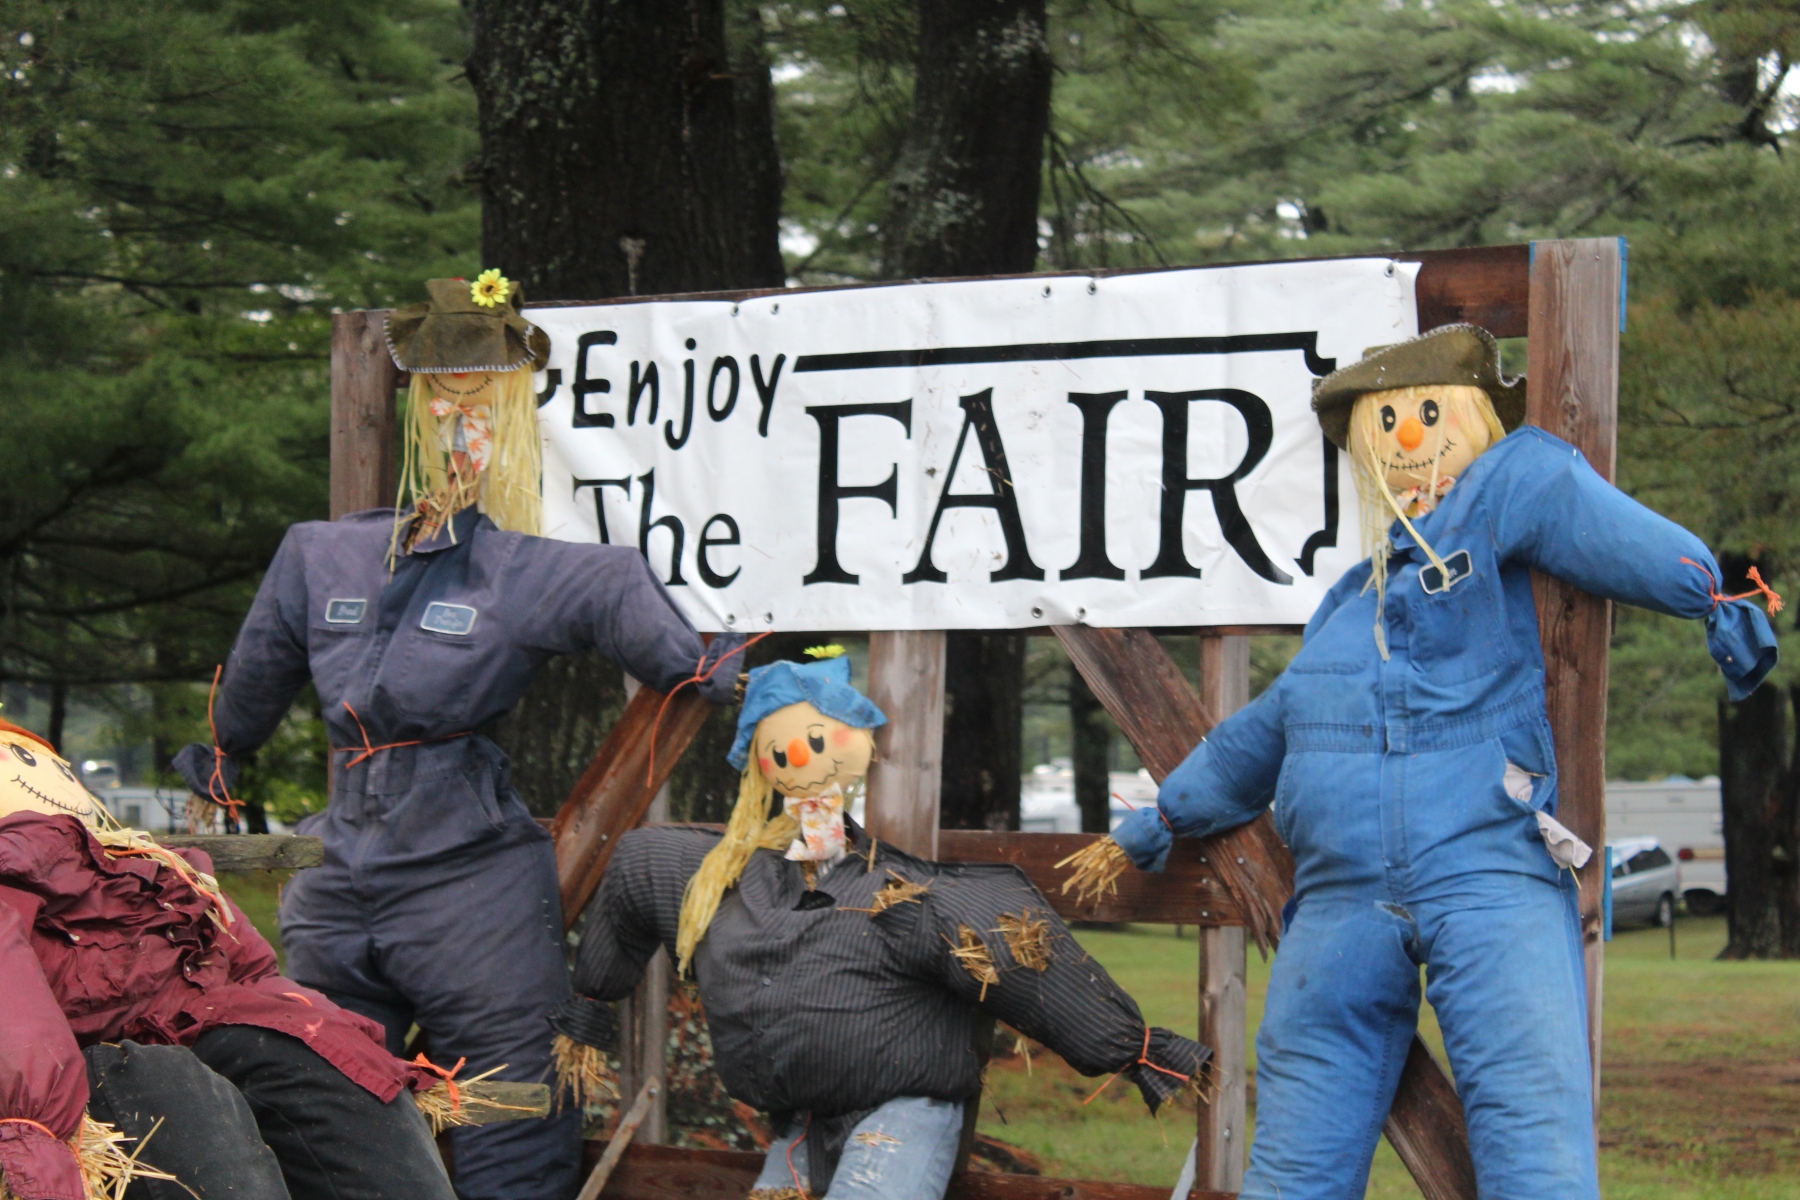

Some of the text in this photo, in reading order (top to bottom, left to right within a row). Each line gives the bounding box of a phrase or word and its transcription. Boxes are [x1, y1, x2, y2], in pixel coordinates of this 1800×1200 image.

[573, 330, 786, 450] Enjoy
[572, 386, 1294, 589] The FAIR
